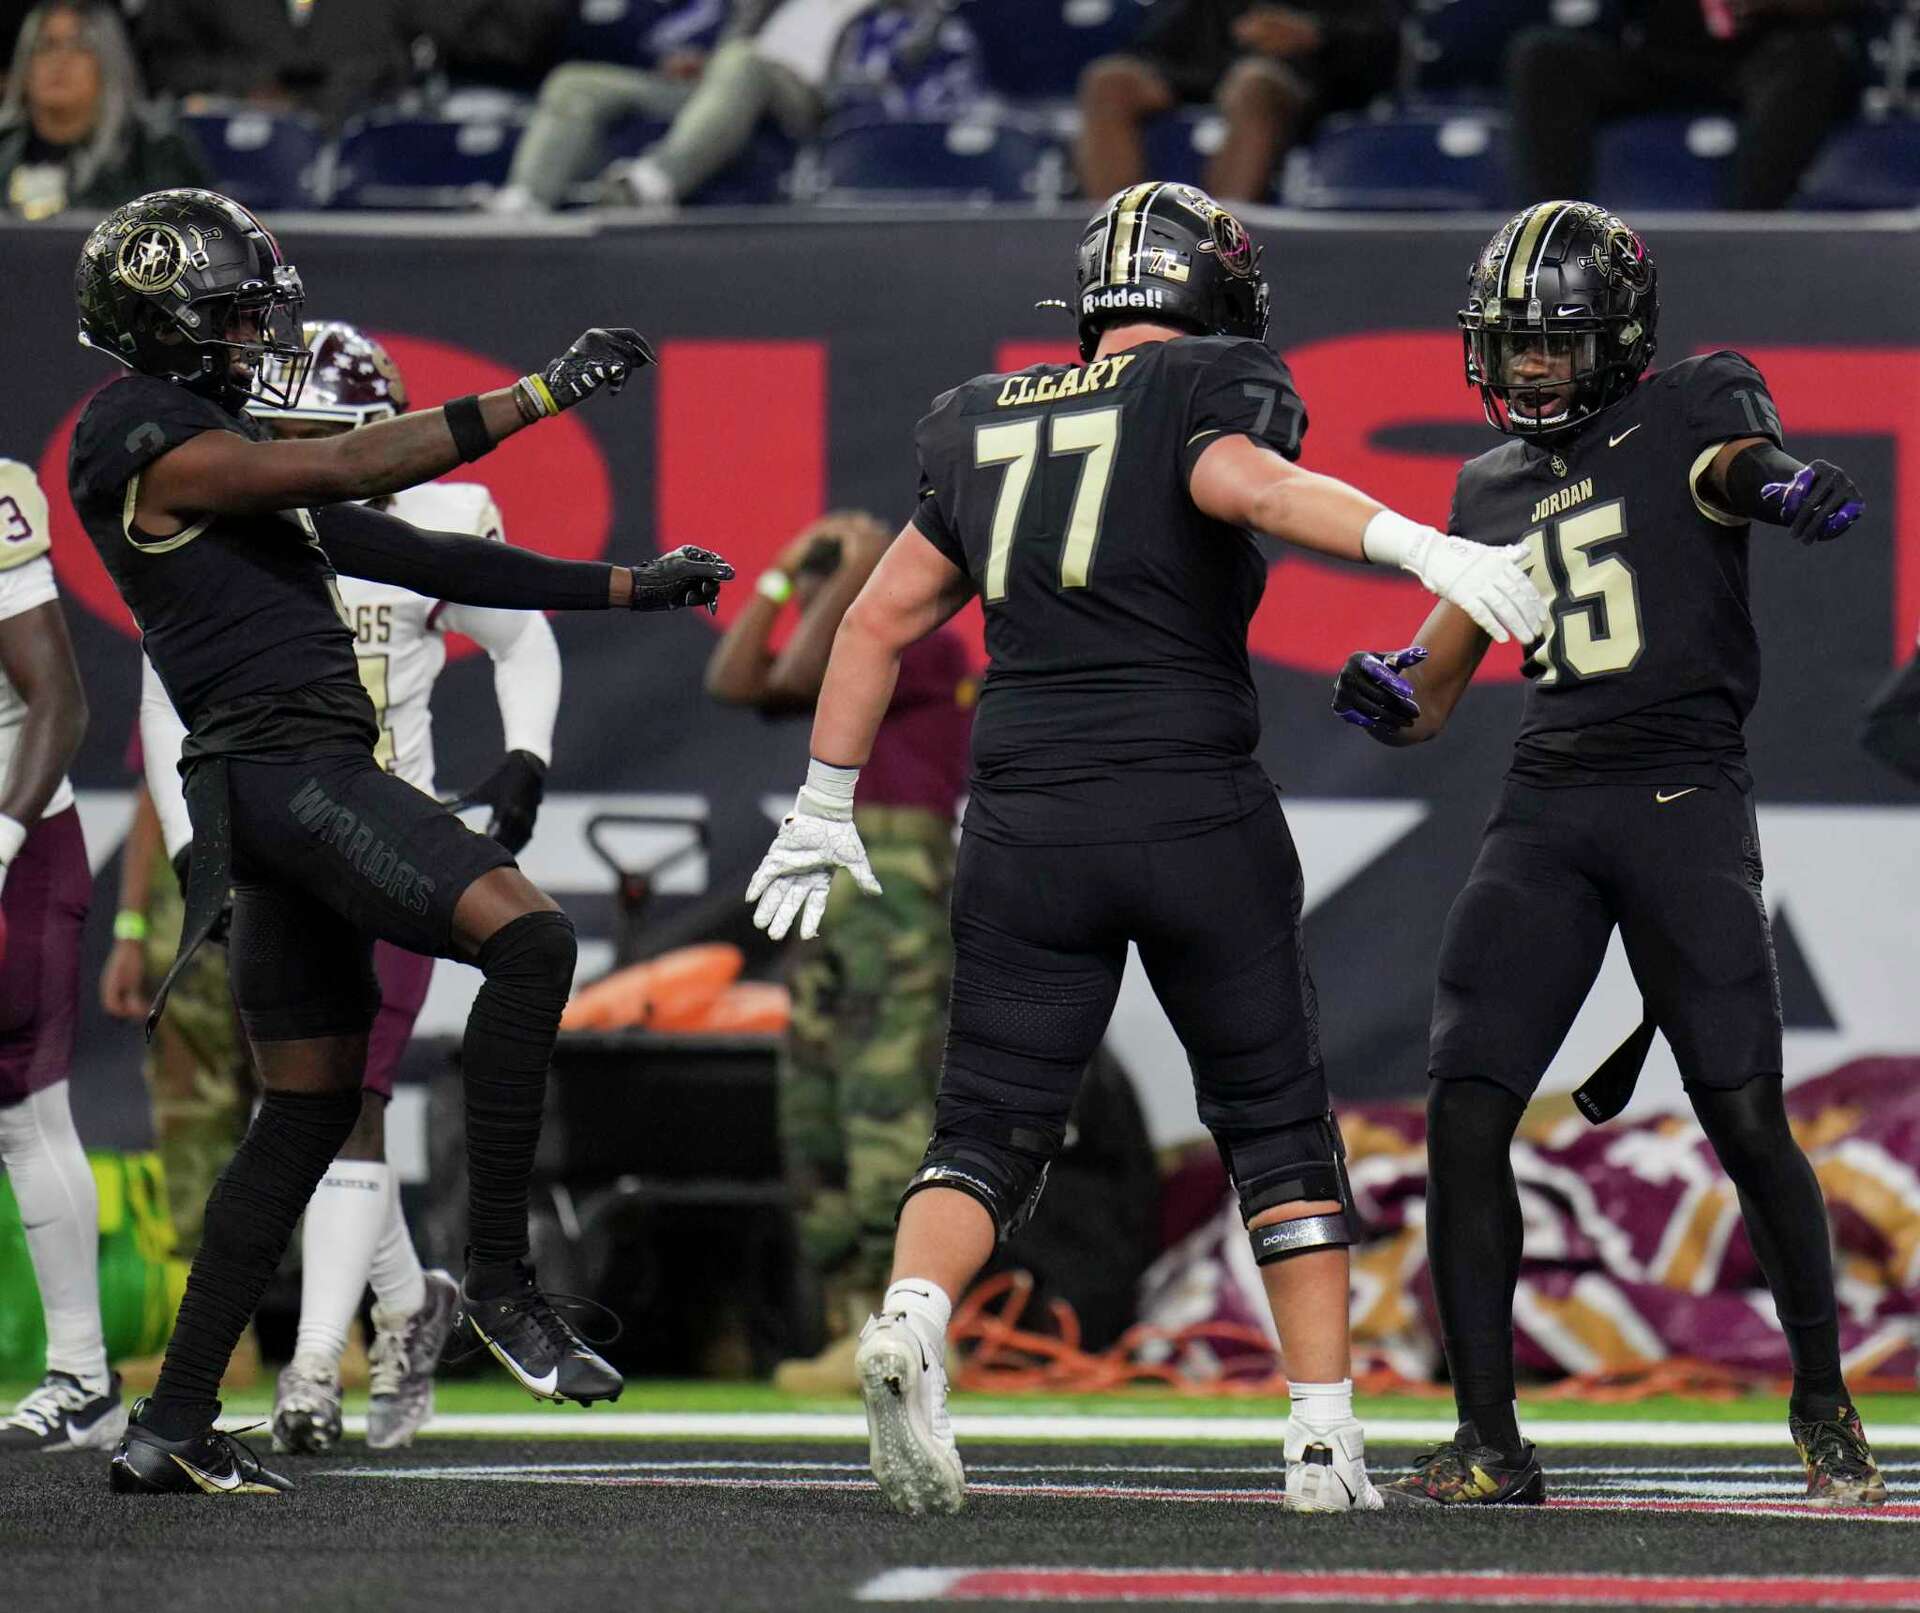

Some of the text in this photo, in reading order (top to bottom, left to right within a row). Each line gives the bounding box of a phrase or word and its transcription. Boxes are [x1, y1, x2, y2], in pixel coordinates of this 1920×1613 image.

[996, 355, 1136, 408] CLEARY
[1243, 384, 1304, 450] 77
[974, 404, 1124, 606] 77
[1531, 477, 1594, 523] JORDAN
[288, 777, 437, 917] WARRIORS
[1262, 1227, 1316, 1247] DONJO
